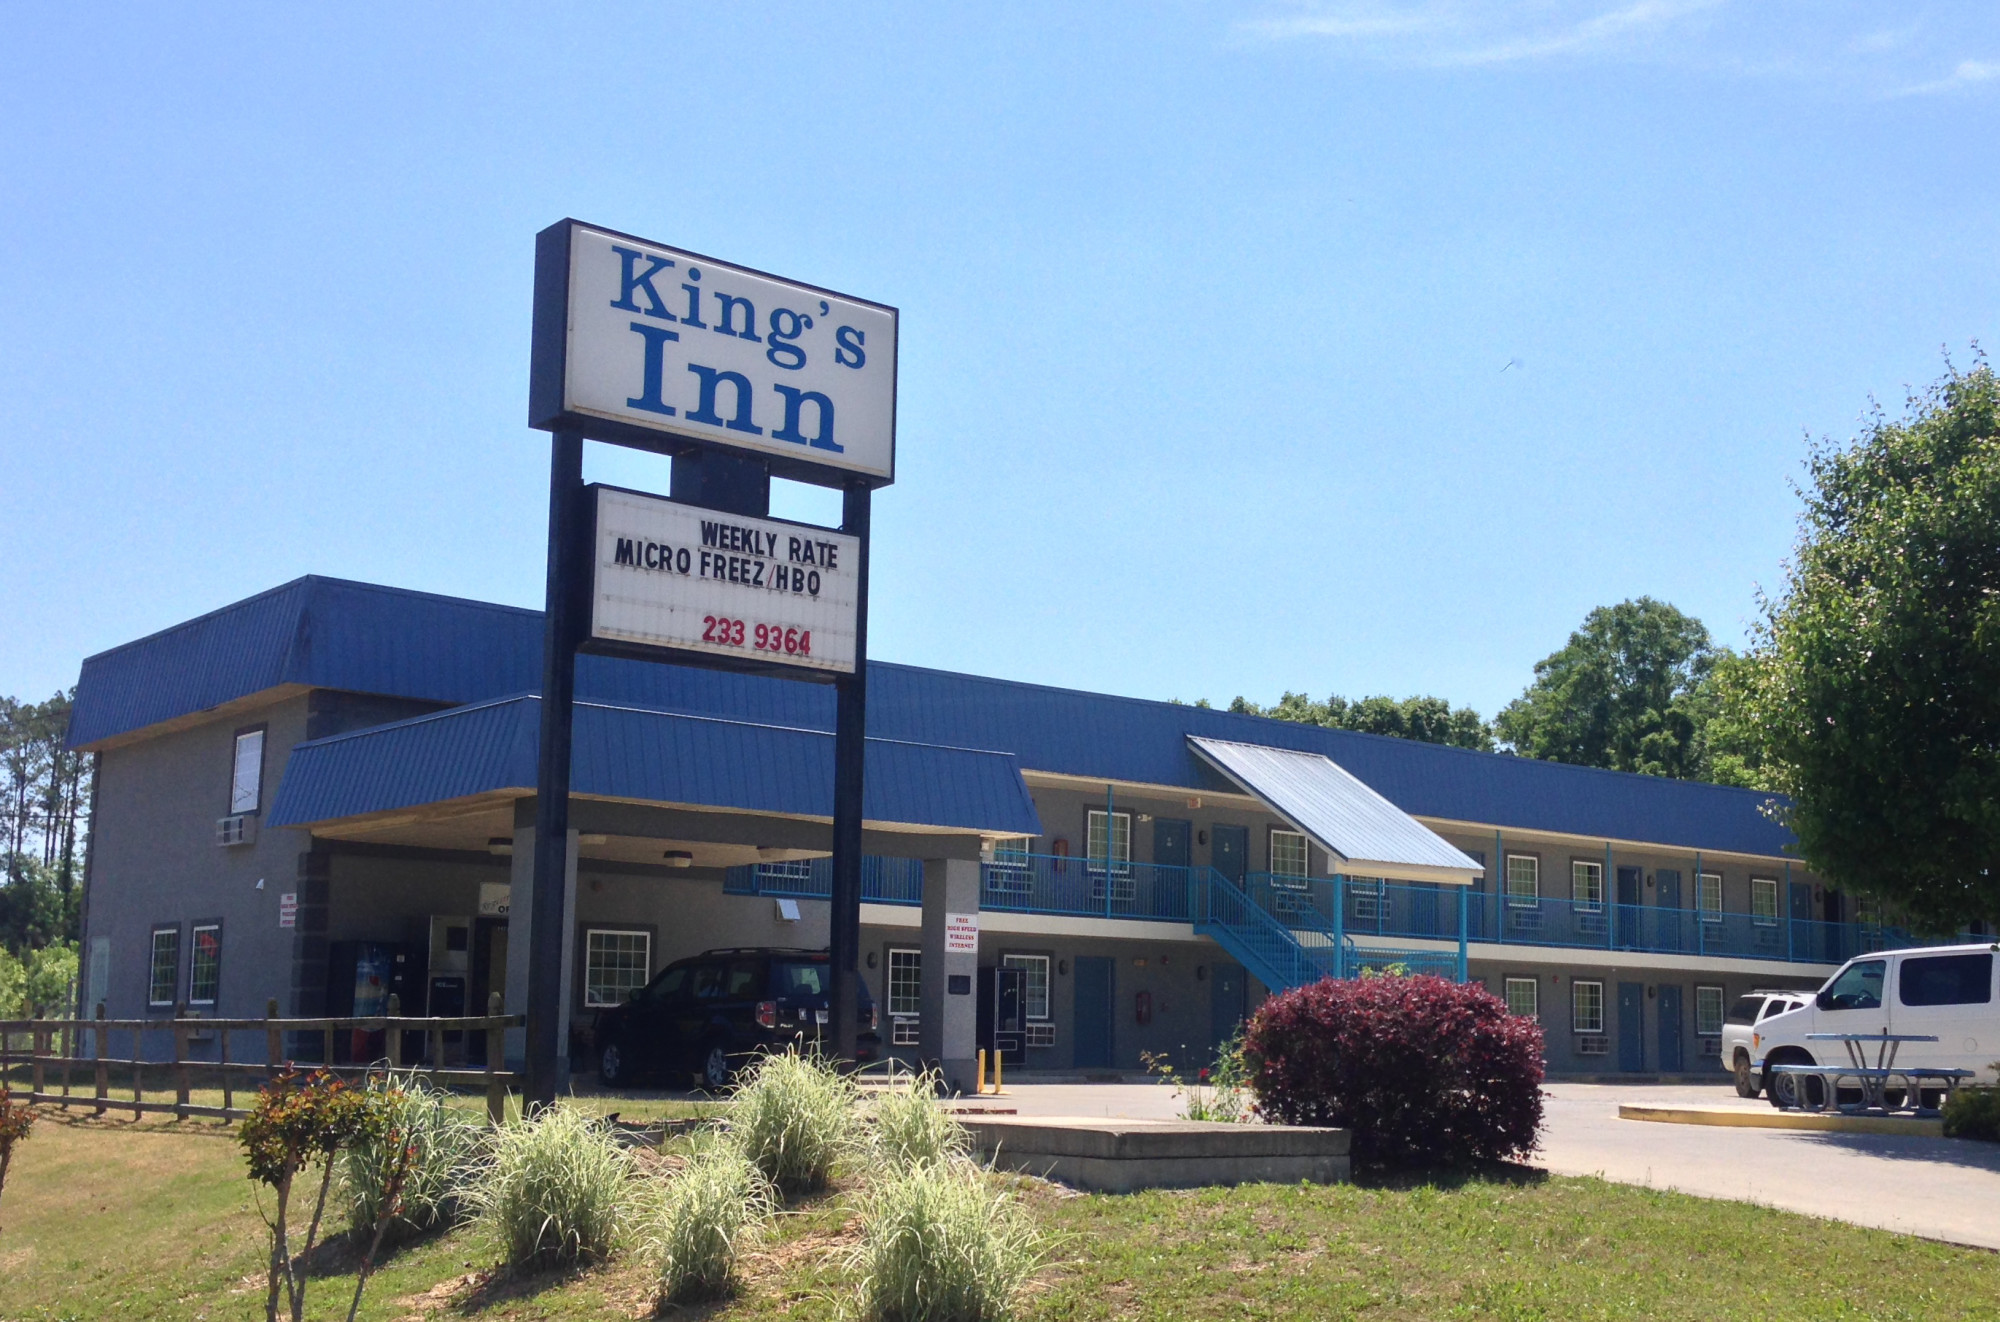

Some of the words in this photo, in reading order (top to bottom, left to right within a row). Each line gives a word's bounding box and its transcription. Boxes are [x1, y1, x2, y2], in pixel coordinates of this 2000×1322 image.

[610, 245, 866, 370] King's
[626, 321, 844, 453] Inn
[614, 537, 691, 574] MICRO
[700, 551, 821, 595] FREEZ/HBO
[700, 520, 777, 557] WEEKLY
[789, 536, 838, 568] RATE
[702, 615, 745, 646] 233
[754, 623, 811, 655] 9364
